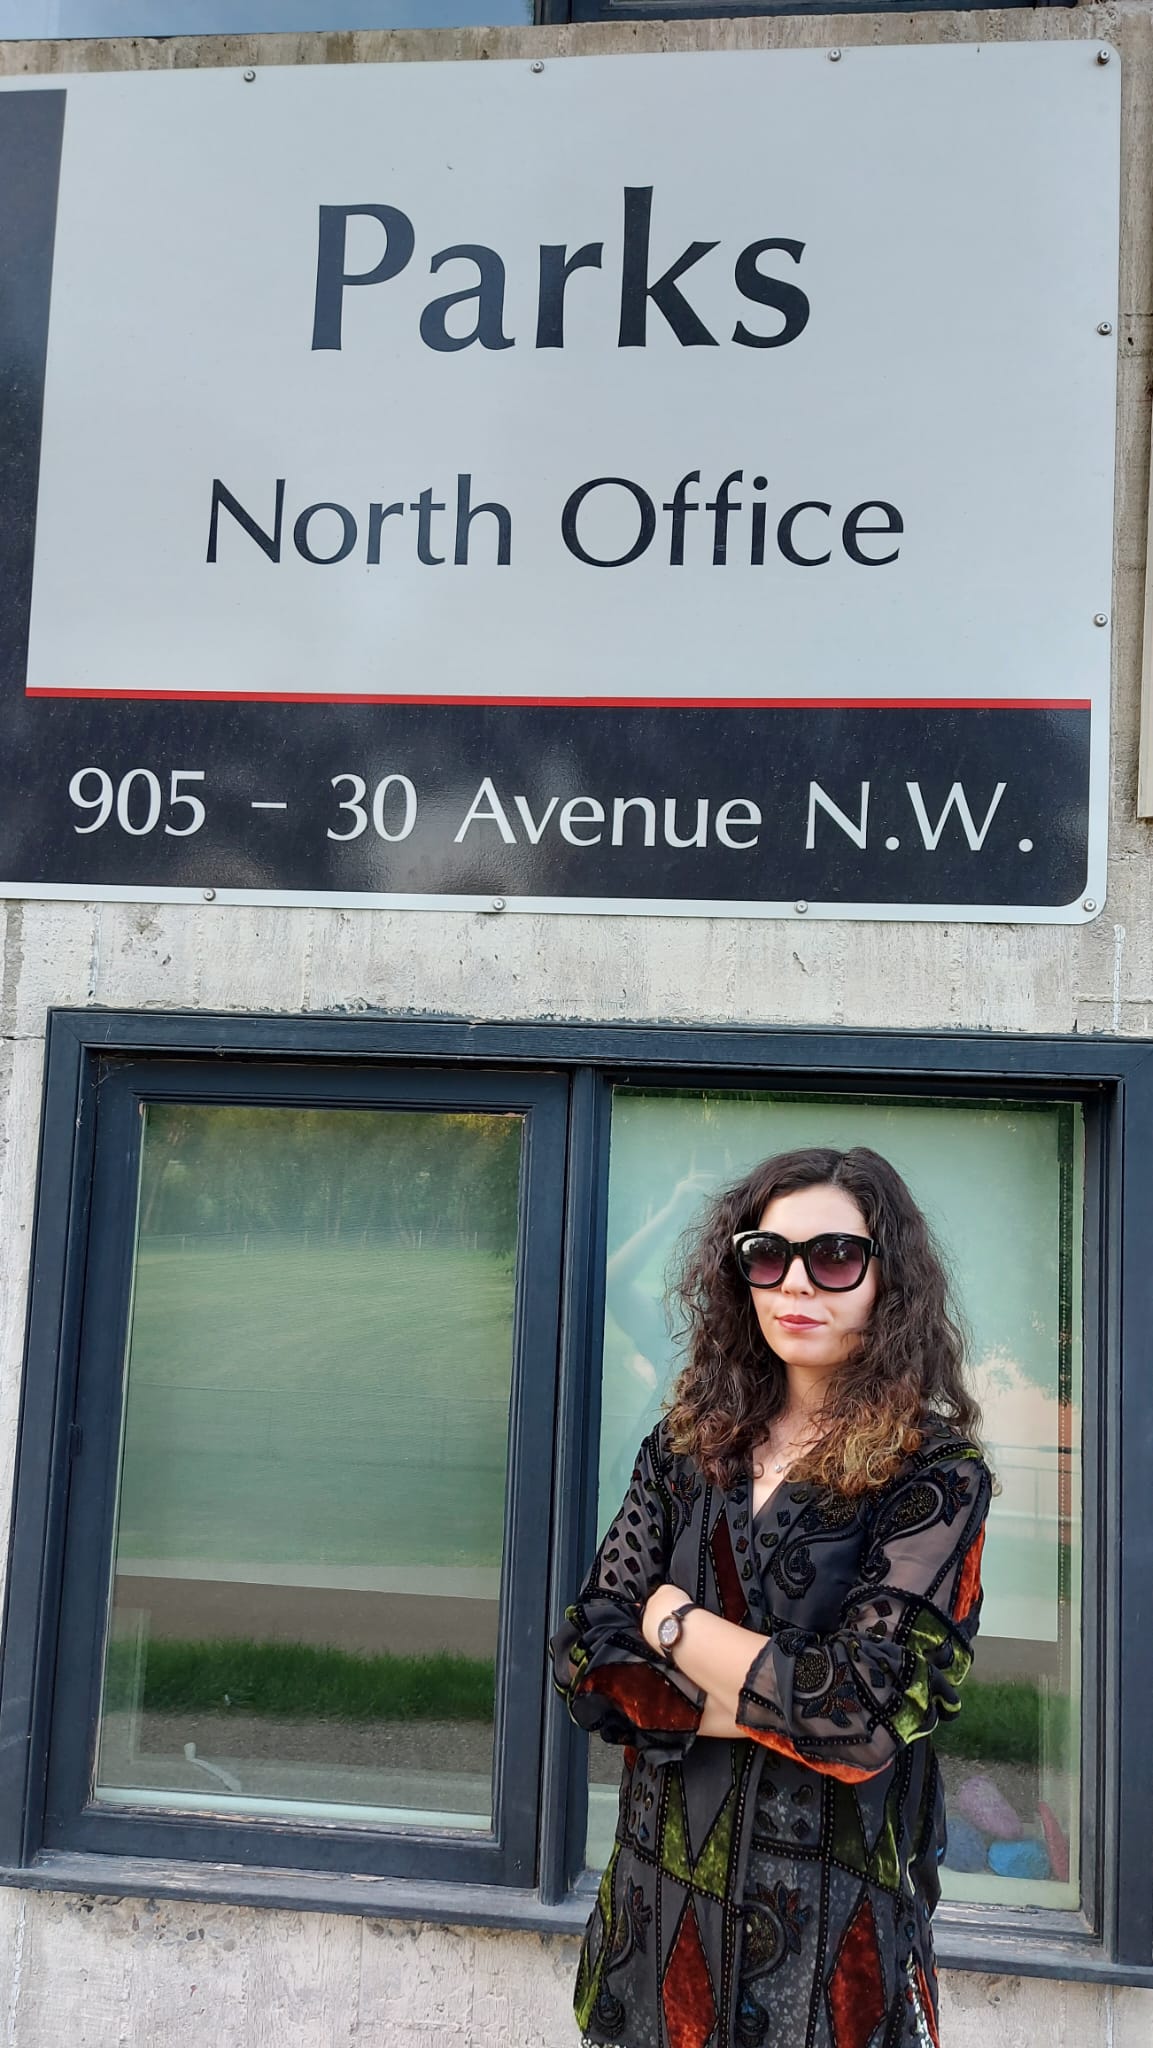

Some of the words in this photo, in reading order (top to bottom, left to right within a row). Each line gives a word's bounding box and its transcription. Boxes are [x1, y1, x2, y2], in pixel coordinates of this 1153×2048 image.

[311, 185, 811, 352] Parks
[205, 473, 512, 566] North
[561, 469, 904, 567] Office
[69, 767, 206, 836] 905
[326, 773, 418, 842] 30
[453, 777, 762, 849] Avenue
[805, 781, 1033, 851] N.W.
